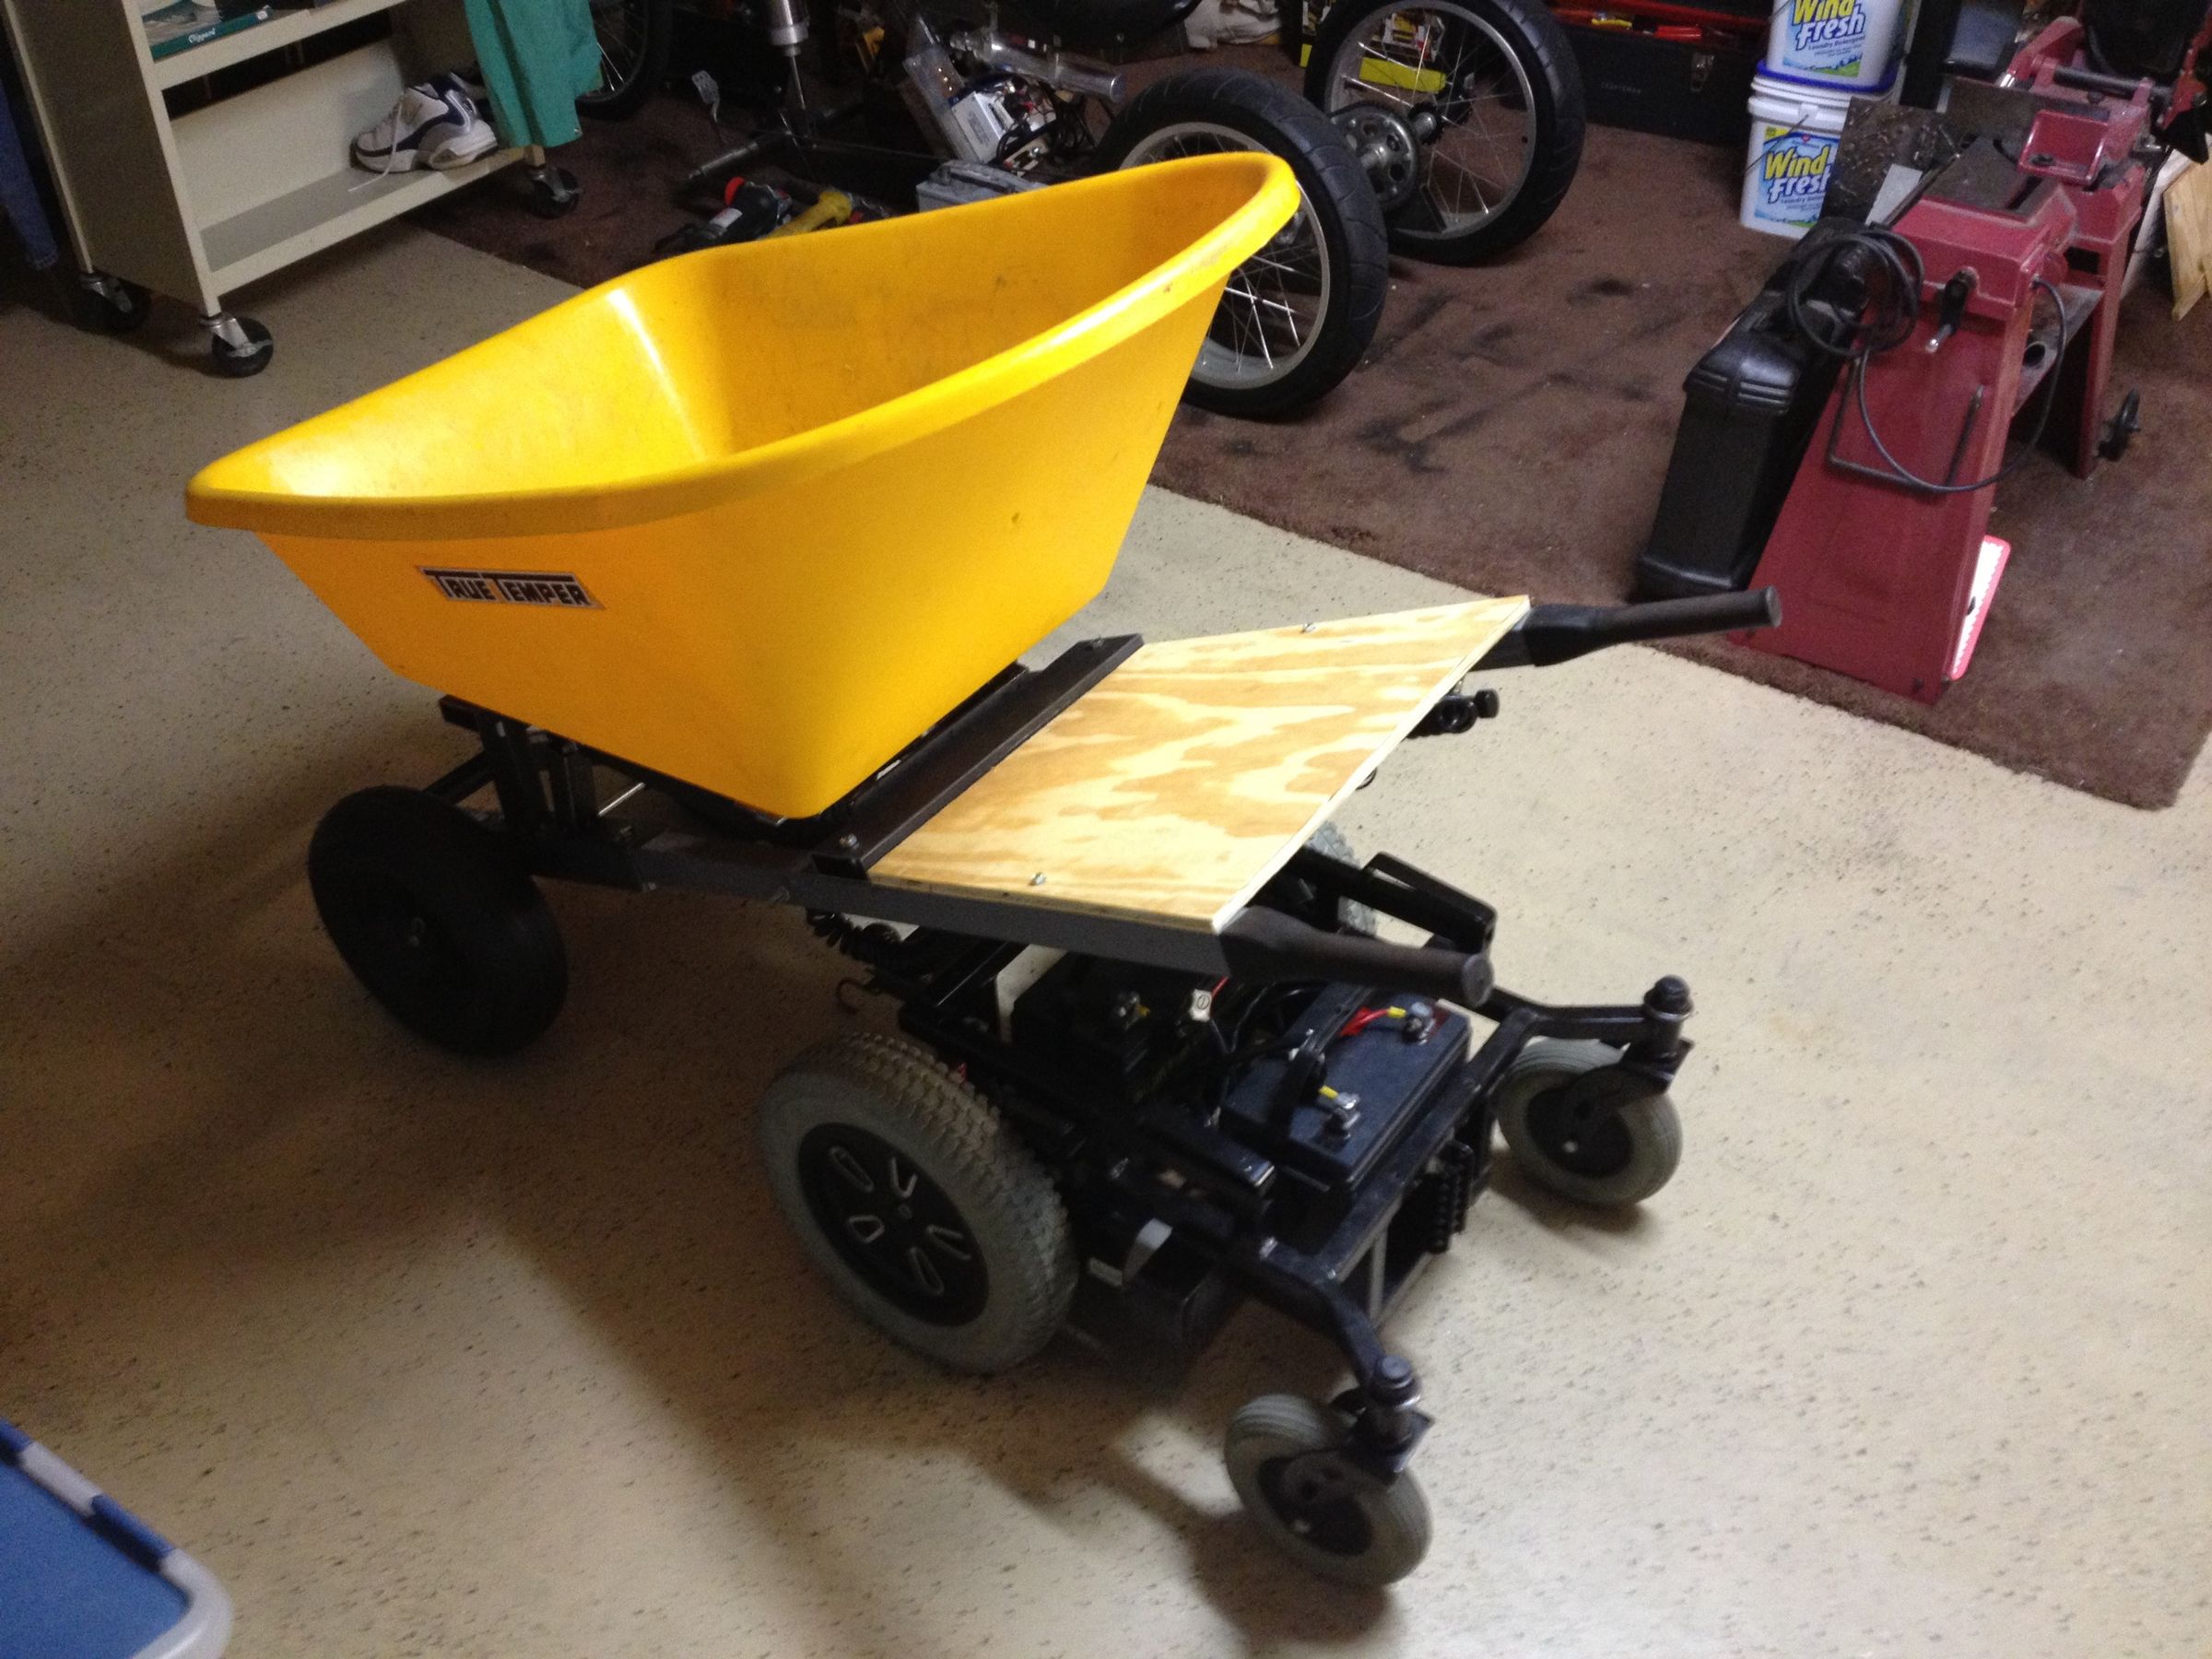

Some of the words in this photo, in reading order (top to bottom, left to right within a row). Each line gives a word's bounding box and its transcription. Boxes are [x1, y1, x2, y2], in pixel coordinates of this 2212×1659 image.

[1792, 0, 1856, 26] Wind
[1795, 4, 1866, 51] Fresh
[1763, 144, 1831, 181] Wind
[423, 569, 498, 601] TRUE
[480, 571, 593, 606] TEMPER
